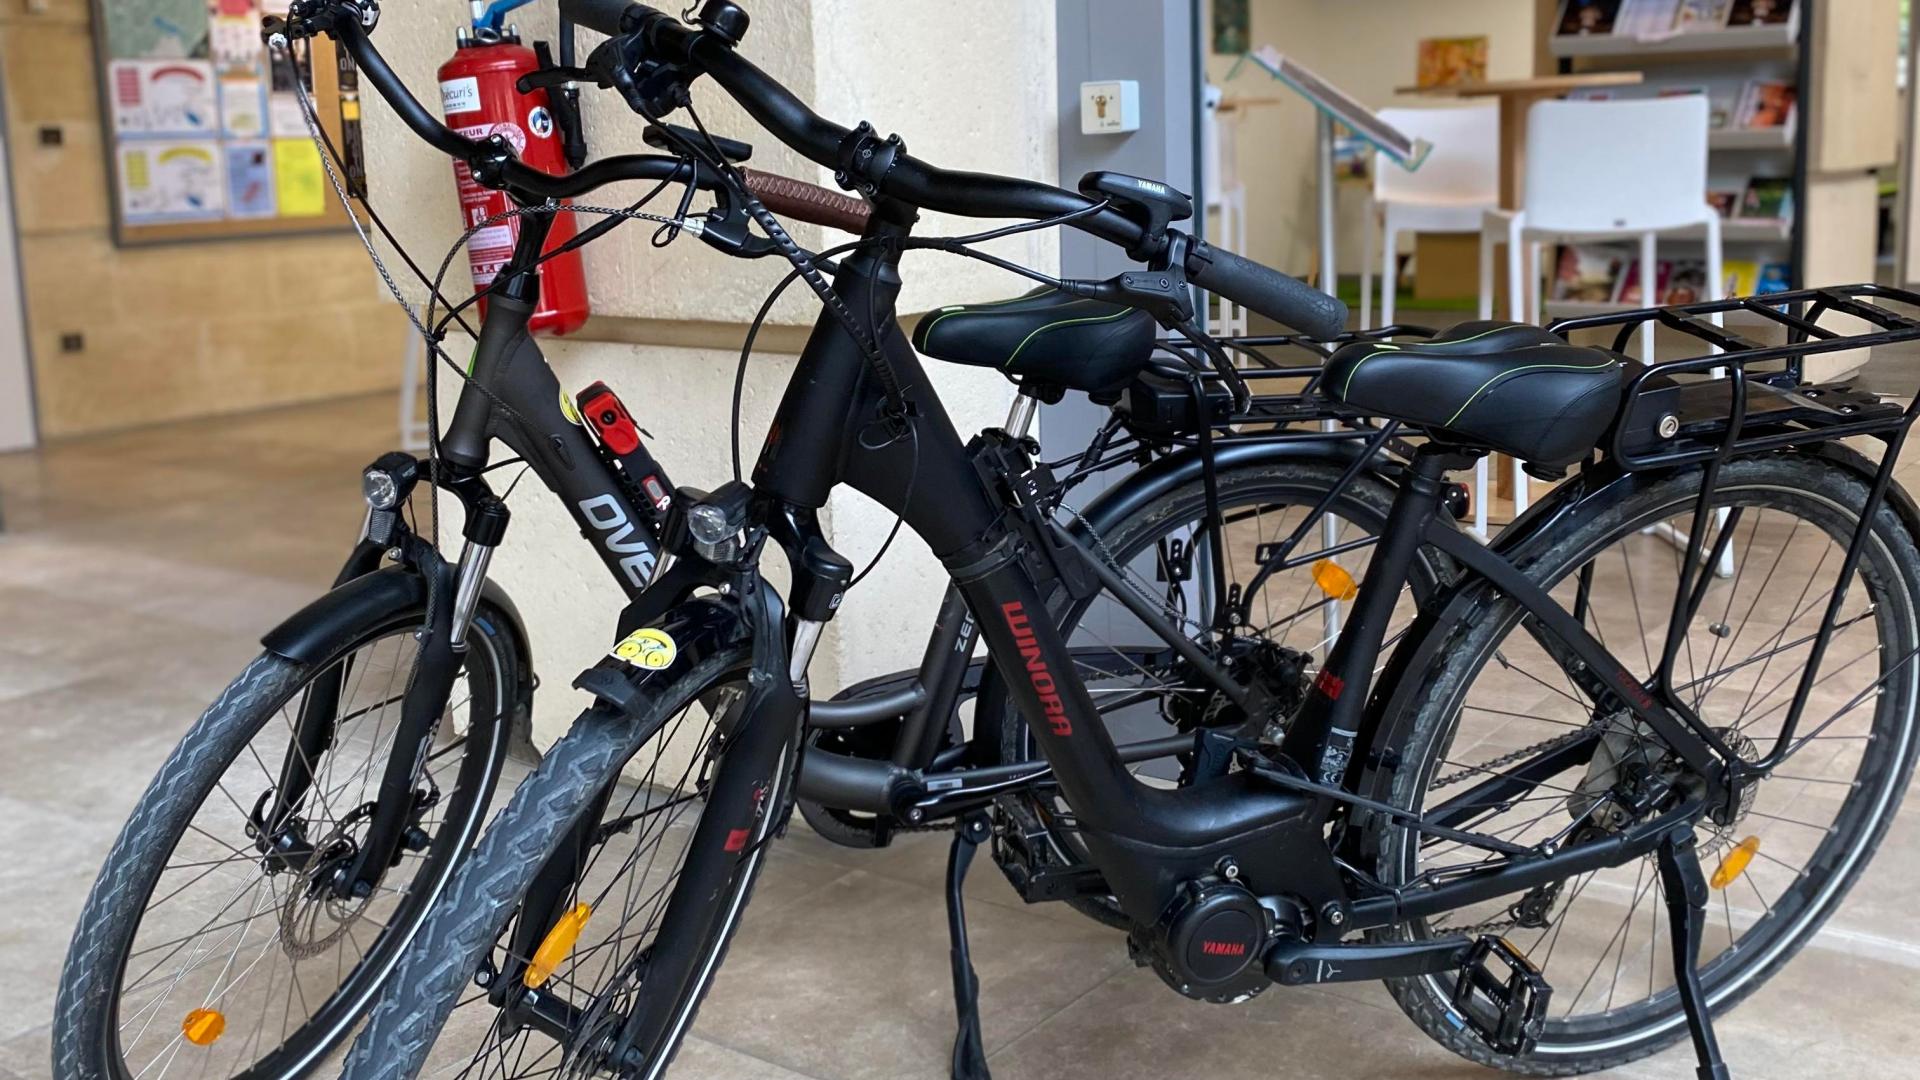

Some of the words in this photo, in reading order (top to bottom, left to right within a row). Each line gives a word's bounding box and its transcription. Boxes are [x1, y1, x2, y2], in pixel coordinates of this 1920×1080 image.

[1138, 180, 1165, 195] YAMAHA
[1001, 601, 1073, 737] WINORA
[1202, 941, 1245, 956] YAMAHA
